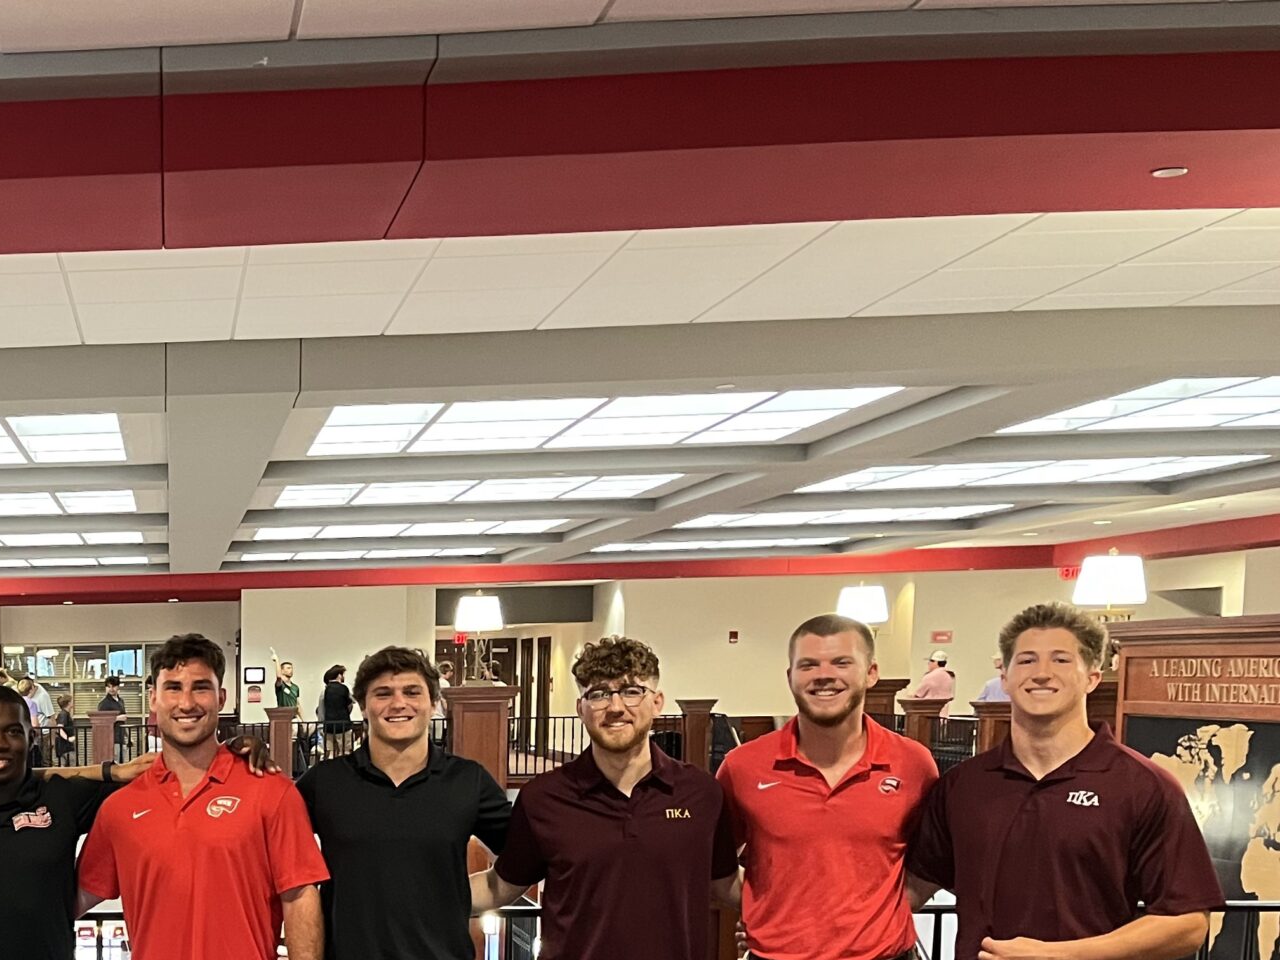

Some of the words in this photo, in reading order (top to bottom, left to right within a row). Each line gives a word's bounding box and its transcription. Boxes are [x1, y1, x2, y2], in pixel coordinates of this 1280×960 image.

[1149, 659, 1160, 678] A
[1163, 658, 1222, 678] LEADING
[1167, 683, 1201, 702] WITH
